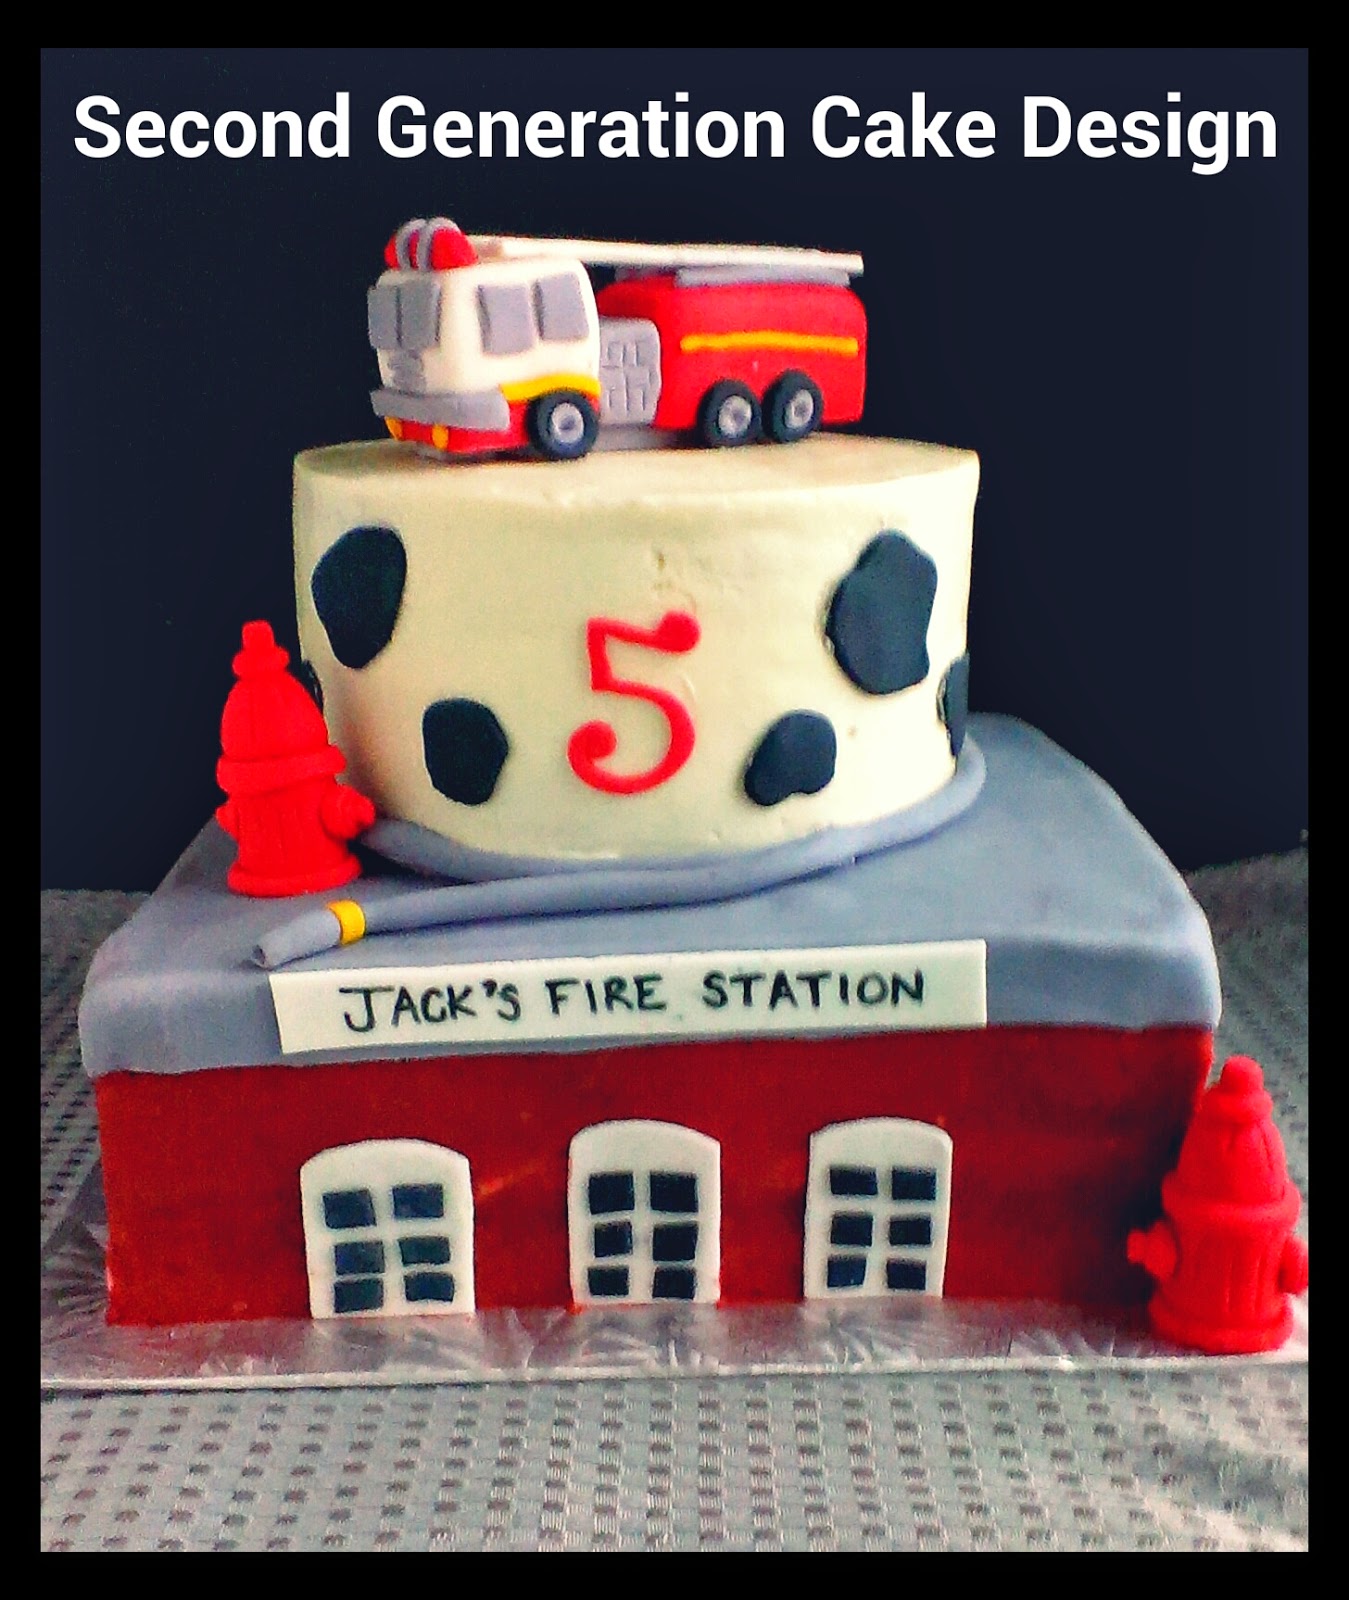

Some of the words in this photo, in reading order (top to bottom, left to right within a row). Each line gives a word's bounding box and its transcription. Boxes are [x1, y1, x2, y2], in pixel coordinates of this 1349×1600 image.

[567, 609, 701, 796] 5
[338, 979, 522, 1033] JACK'S
[545, 970, 667, 1016] FIRE
[702, 969, 924, 1010] STATION
